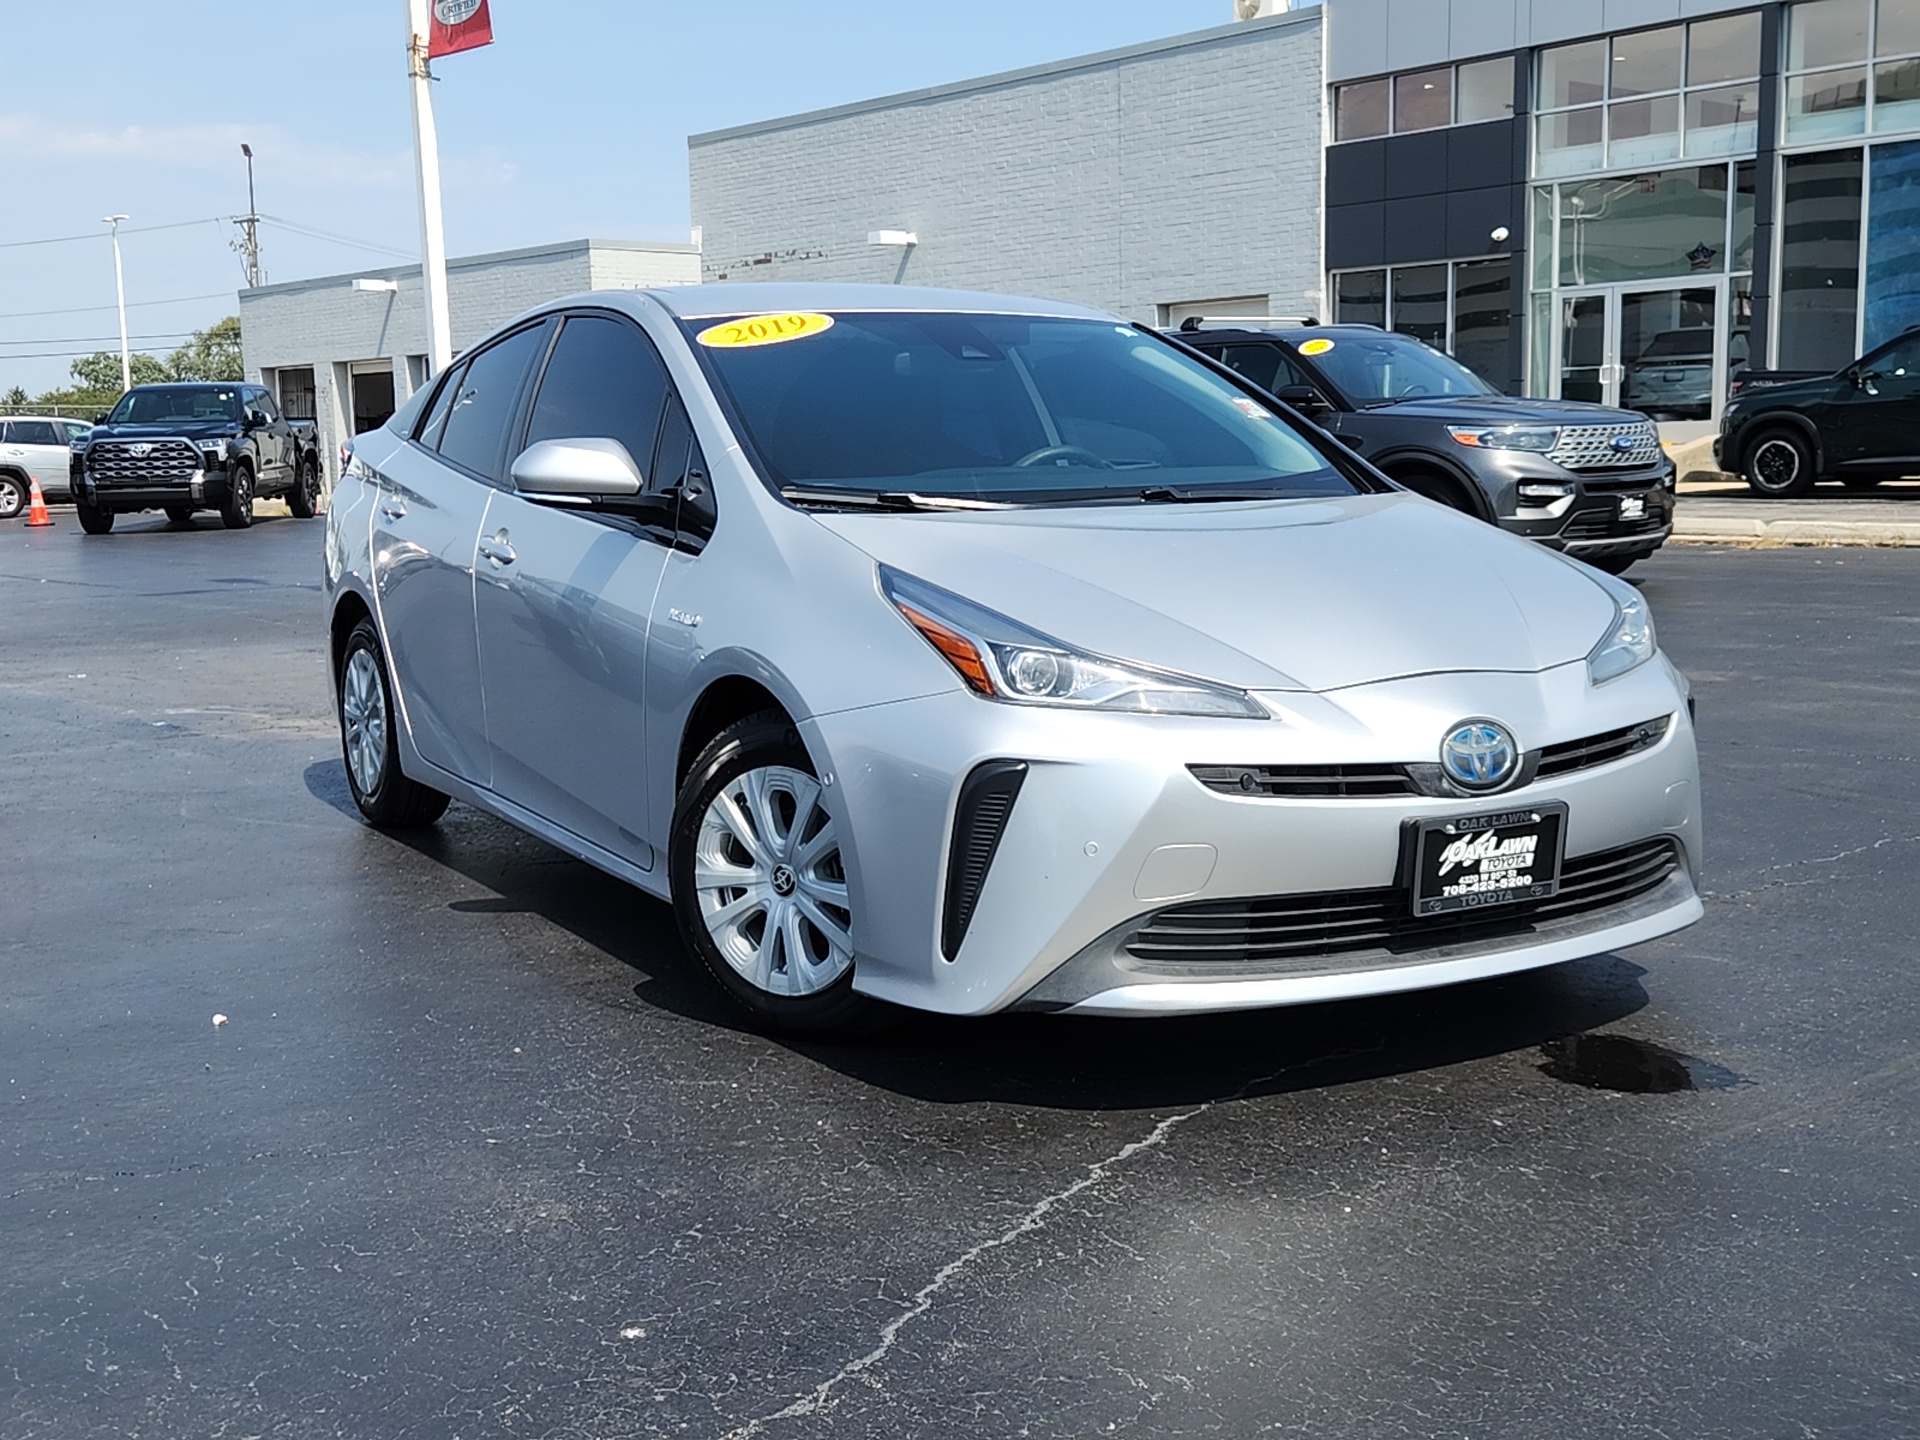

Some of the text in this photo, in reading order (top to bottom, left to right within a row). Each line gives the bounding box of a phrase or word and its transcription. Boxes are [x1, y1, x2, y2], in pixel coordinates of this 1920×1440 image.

[725, 315, 806, 344] 2019
[1459, 811, 1531, 830] OAK LAWN
[1487, 855, 1528, 869] TOYOTA
[1442, 874, 1532, 897] 708-423-5200
[1460, 889, 1513, 906] TOYOTA
